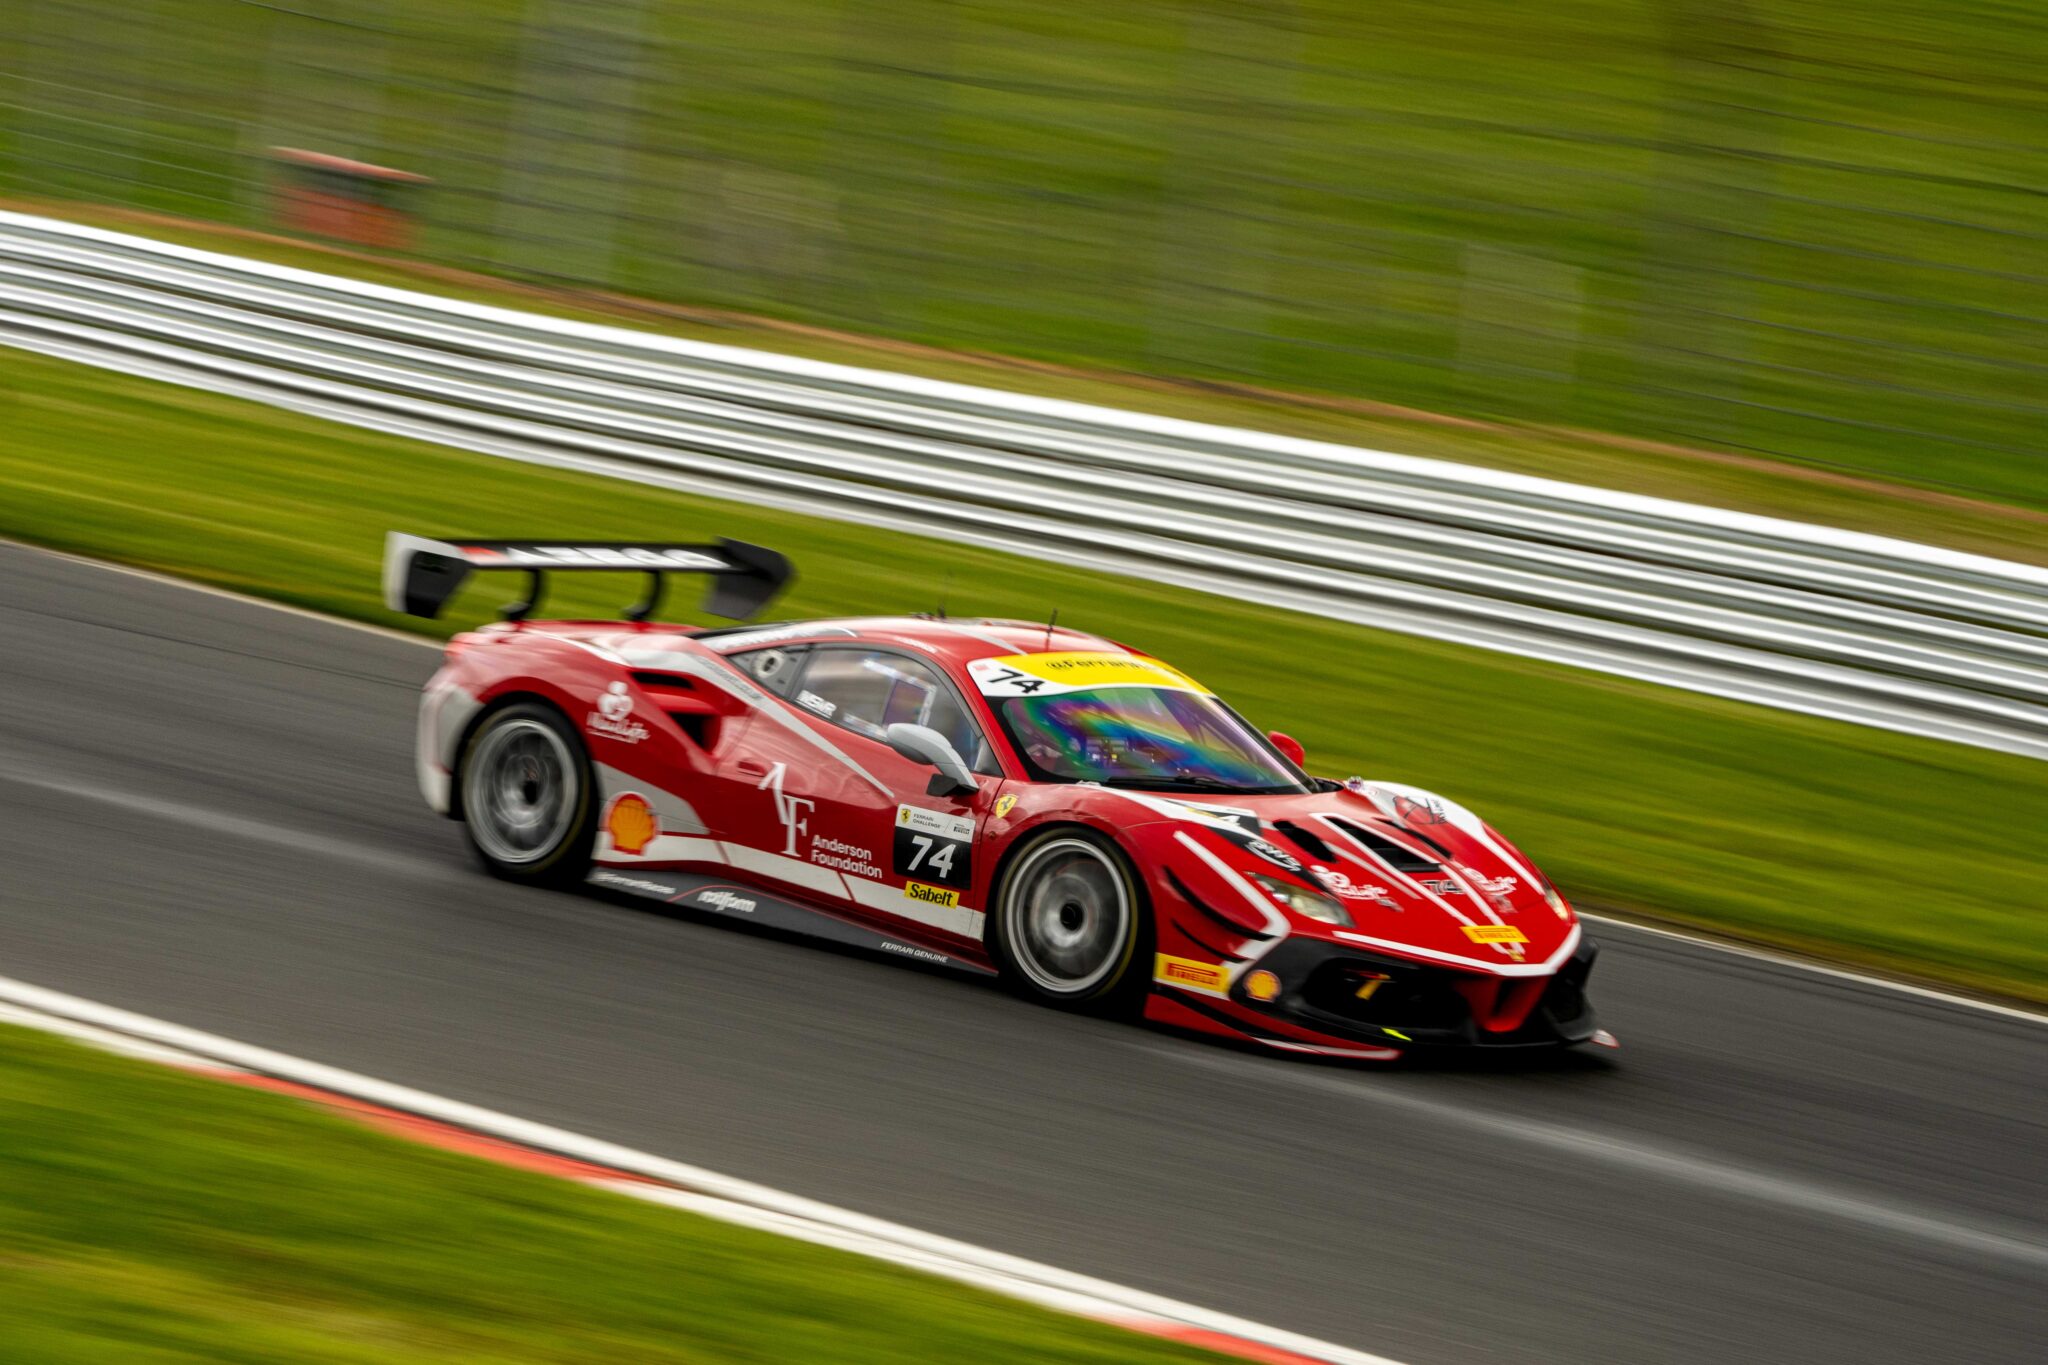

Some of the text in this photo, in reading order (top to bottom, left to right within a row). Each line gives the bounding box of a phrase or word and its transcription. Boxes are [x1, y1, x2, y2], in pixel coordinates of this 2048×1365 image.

[988, 668, 1045, 694] 74
[913, 818, 941, 829] CHALLENGE
[811, 834, 872, 861] Anderson
[906, 834, 957, 879] 74
[811, 850, 882, 879] Foundation
[909, 883, 953, 907] Sabelt
[881, 941, 949, 963] FERRARI GENUINE
